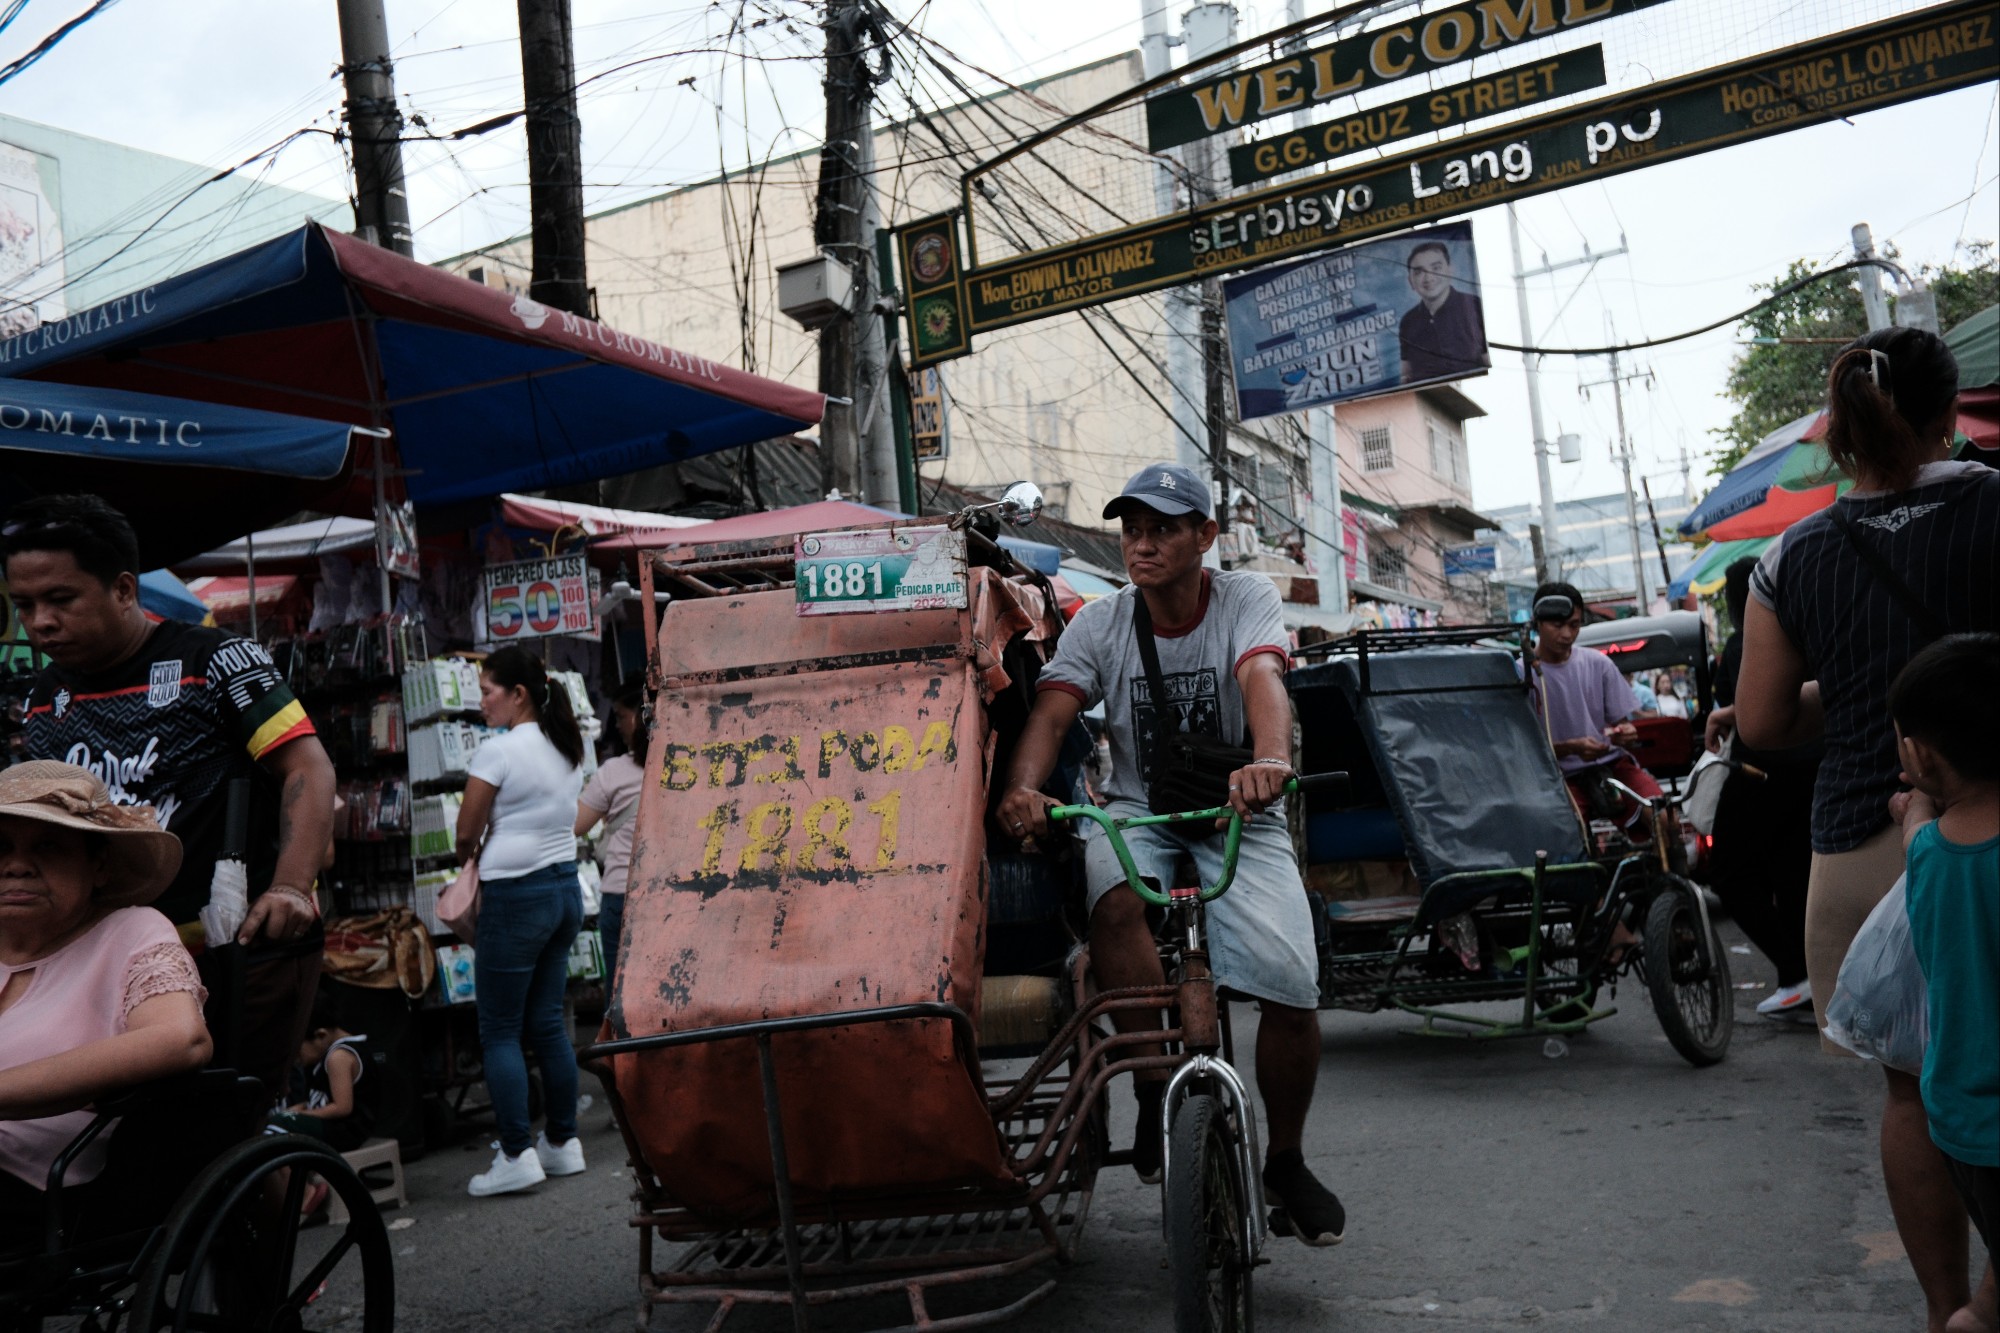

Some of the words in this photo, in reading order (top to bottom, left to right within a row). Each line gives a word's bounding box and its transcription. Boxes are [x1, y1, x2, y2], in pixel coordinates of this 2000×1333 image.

[1191, 0, 1613, 131] WELCOME
[1253, 138, 1315, 174] G.G.
[1323, 107, 1411, 154] CRUZ
[1430, 63, 1560, 123] STREET
[1410, 140, 1532, 199] Lang
[1586, 108, 1662, 165] po
[1254, 226, 1323, 254] MARVIN
[1340, 203, 1411, 232] SANTOS
[1539, 159, 1582, 182] JUN
[1010, 293, 1046, 312] CITY
[1053, 277, 1113, 302] MAYOR
[1011, 263, 1062, 298] EDWIN
[1254, 270, 1303, 302] GAWIN
[1307, 254, 1354, 284] NATIN
[1258, 284, 1322, 320] POSIBLE
[1326, 272, 1356, 297] ANG
[0, 287, 157, 364] MICROMATIC
[1270, 294, 1354, 335] IMPOSIBLE
[561, 313, 721, 383] MICROMATIC
[1243, 342, 1302, 374] BATANG
[1308, 337, 1378, 378] JUN
[1284, 360, 1382, 409] ZAIDE
[485, 562, 543, 587] TEMPERED
[546, 558, 582, 580] GLASS
[560, 586, 585, 604] 100
[802, 561, 883, 598] 1881
[895, 584, 933, 597] PEDICAB
[935, 582, 961, 594] PLATE
[490, 581, 559, 637] 50
[563, 611, 587, 630] 100
[914, 597, 946, 609] 2022
[818, 720, 958, 779] PODA
[697, 789, 900, 879] 1881
